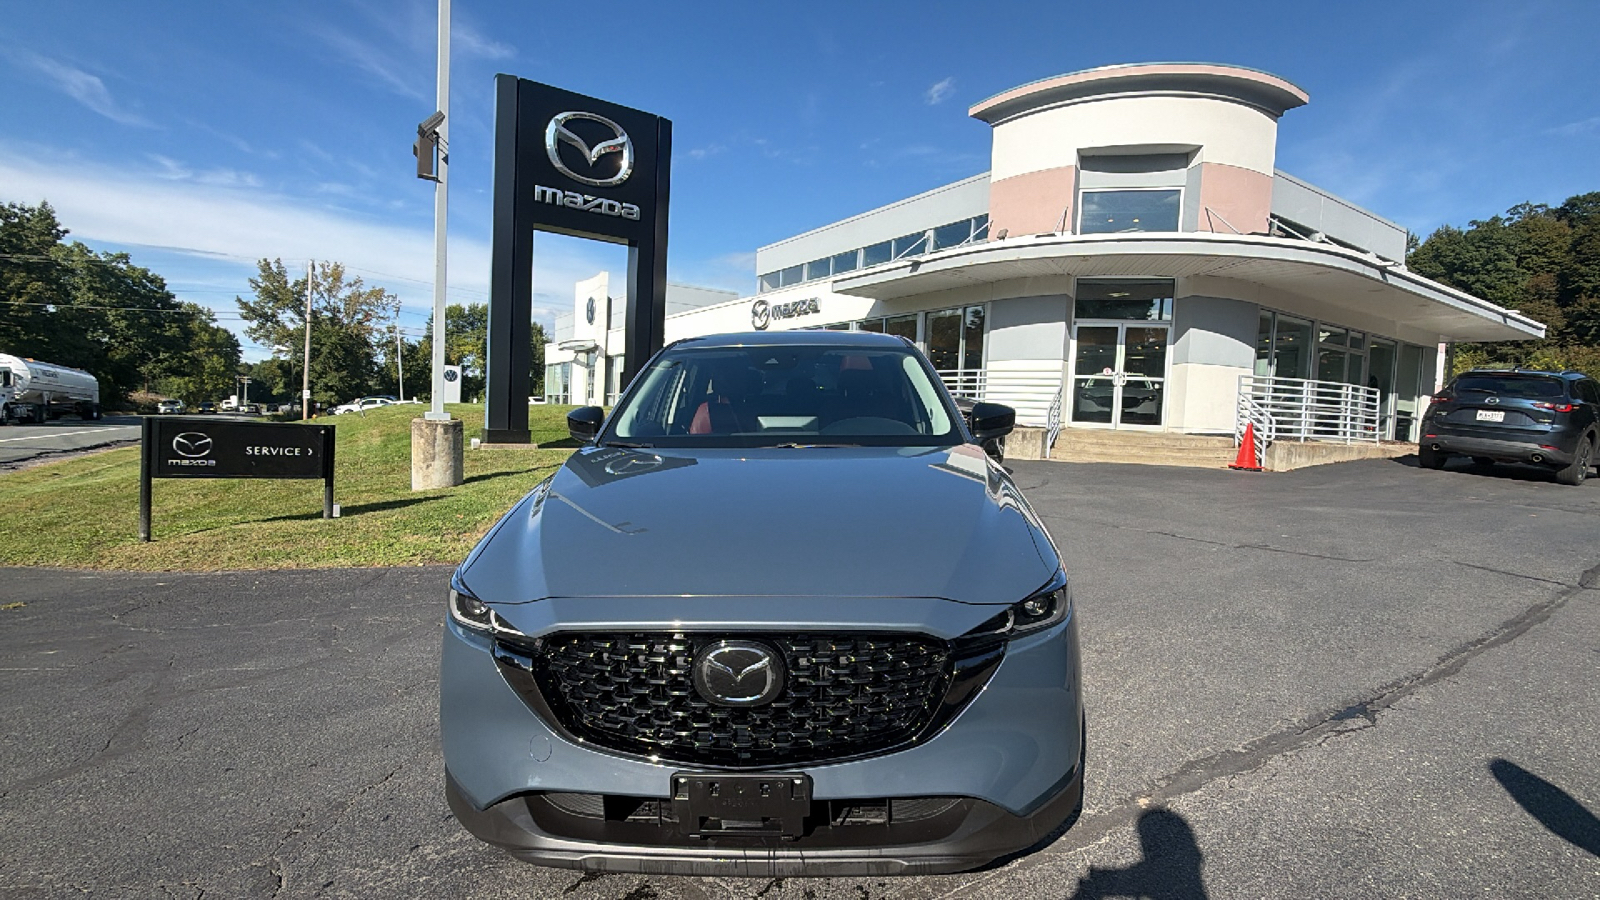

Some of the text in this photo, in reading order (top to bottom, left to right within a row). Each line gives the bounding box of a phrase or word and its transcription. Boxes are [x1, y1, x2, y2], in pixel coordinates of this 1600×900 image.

[534, 184, 641, 221] mazda
[245, 446, 301, 456] SERVICE
[168, 459, 216, 467] mazda
